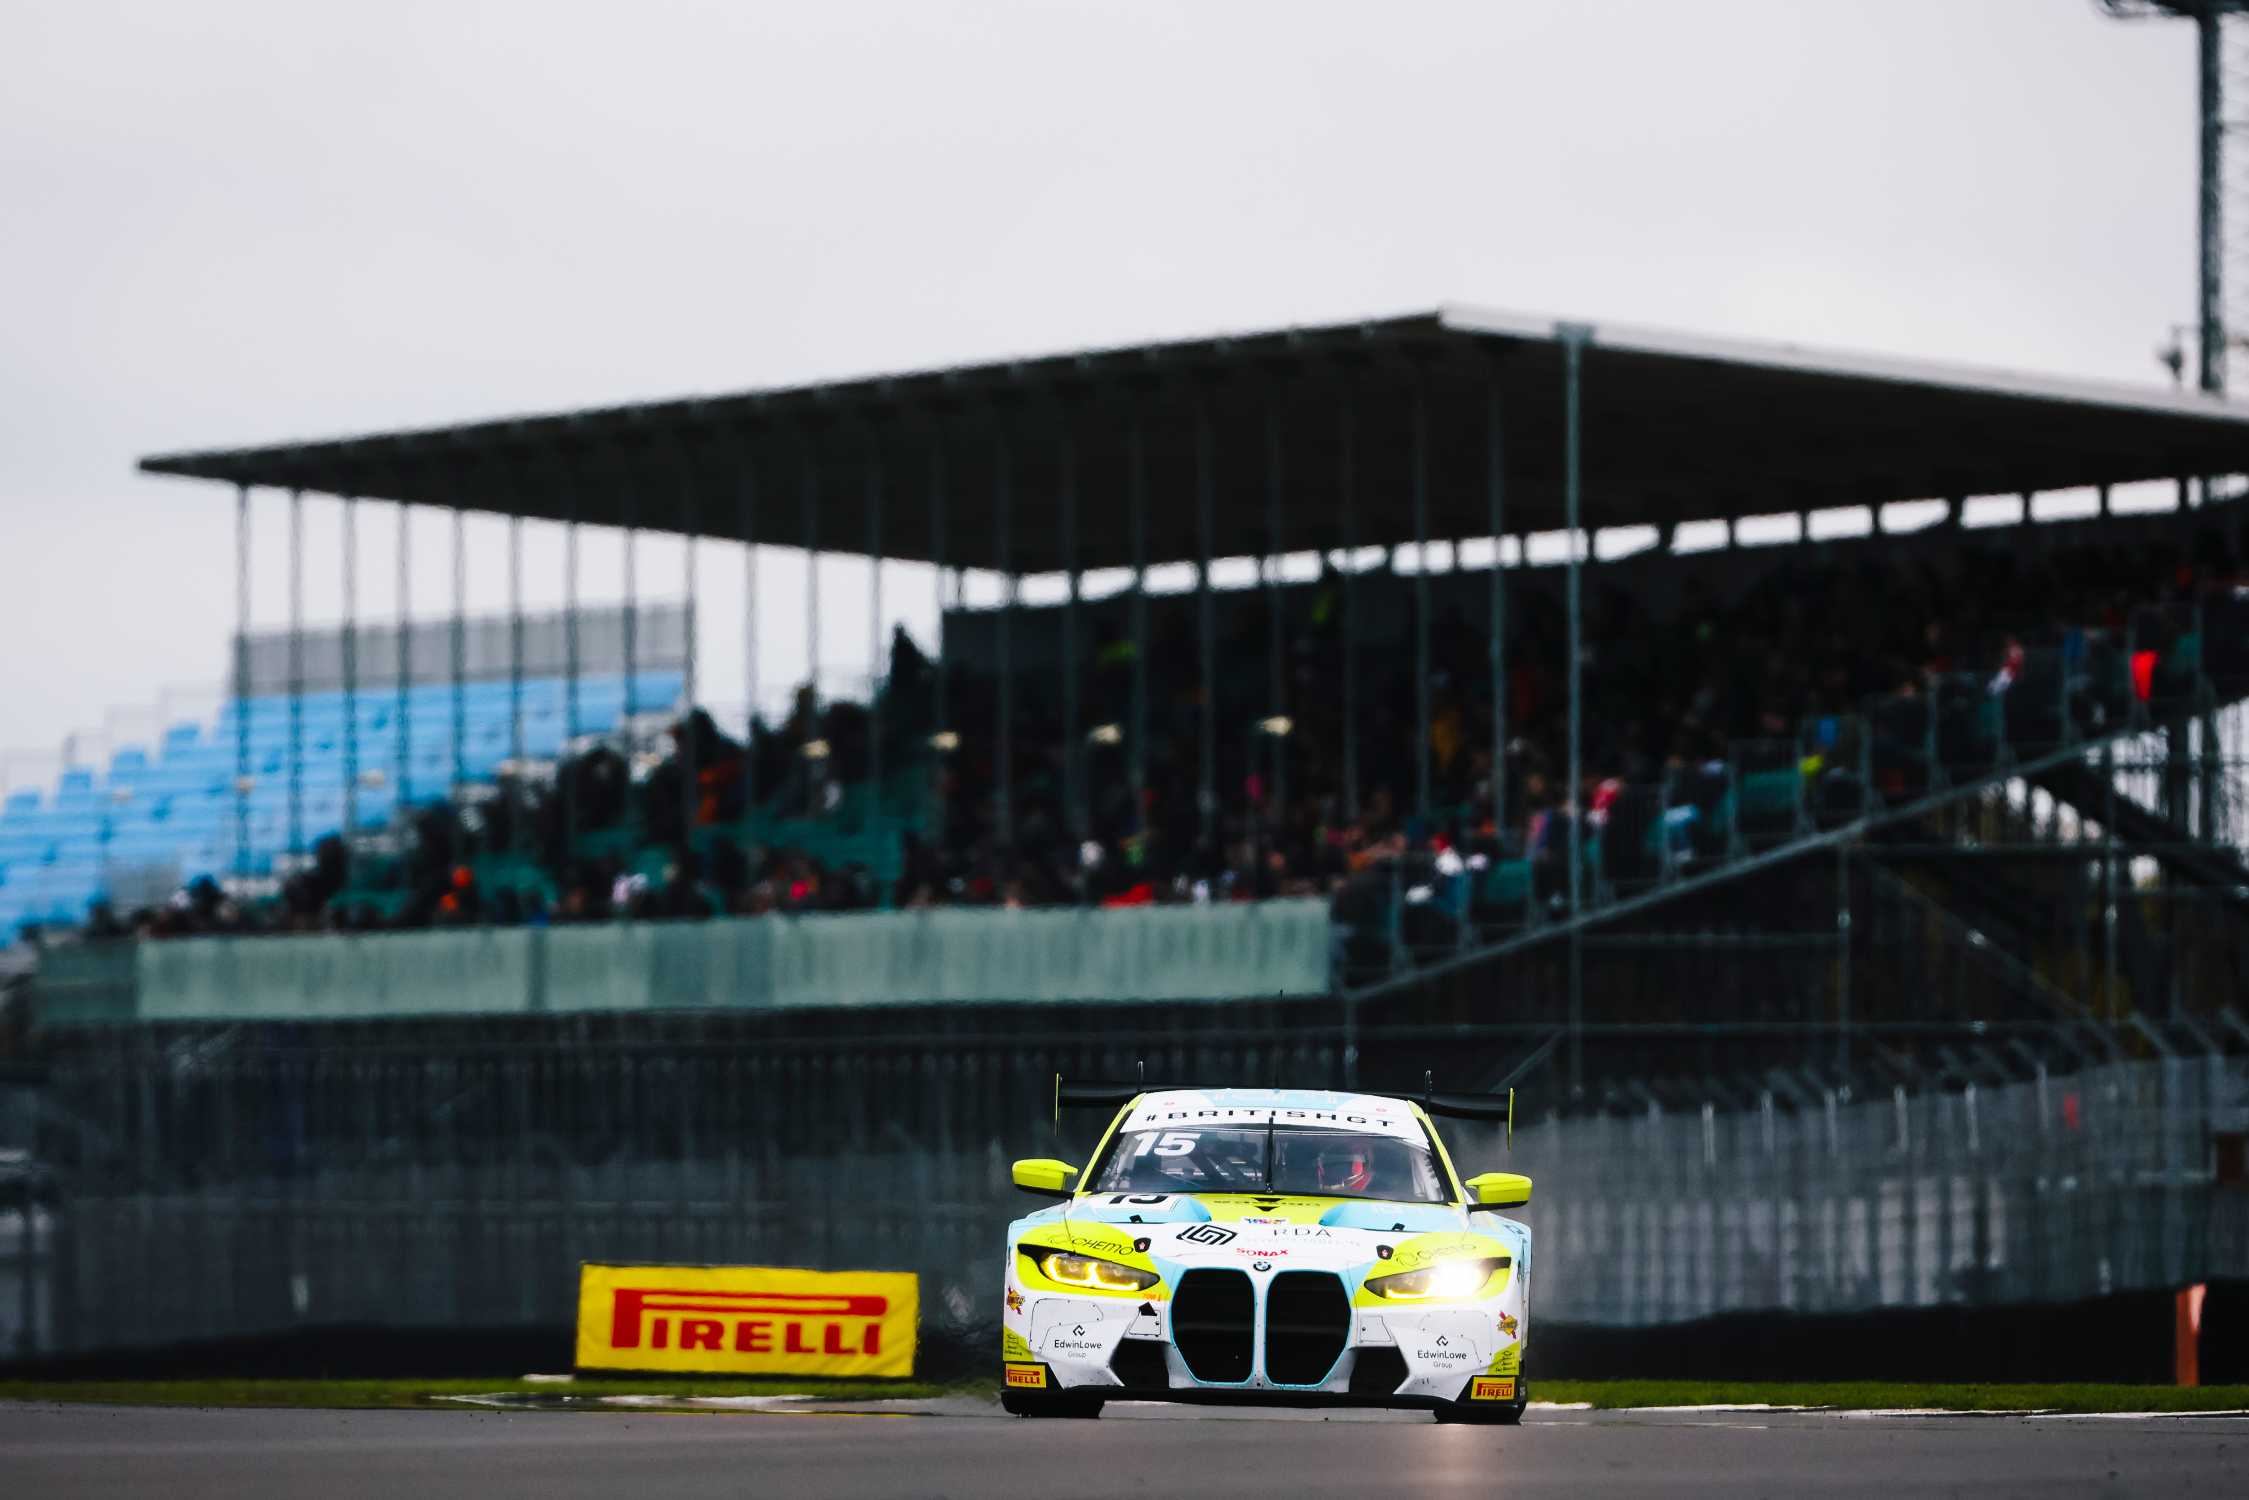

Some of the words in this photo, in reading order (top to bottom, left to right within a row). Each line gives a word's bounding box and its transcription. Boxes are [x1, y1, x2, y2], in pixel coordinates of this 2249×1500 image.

[1133, 1132, 1202, 1157] 15
[1236, 1247, 1289, 1257] SONAX
[611, 1288, 888, 1355] PIRELLI
[1054, 1339, 1103, 1349] EdwinLowe
[1417, 1350, 1467, 1360] EdwinLowe
[1433, 1361, 1453, 1369] Group
[1007, 1368, 1041, 1385] PIRELLI
[1476, 1382, 1513, 1397] PIRELLI
